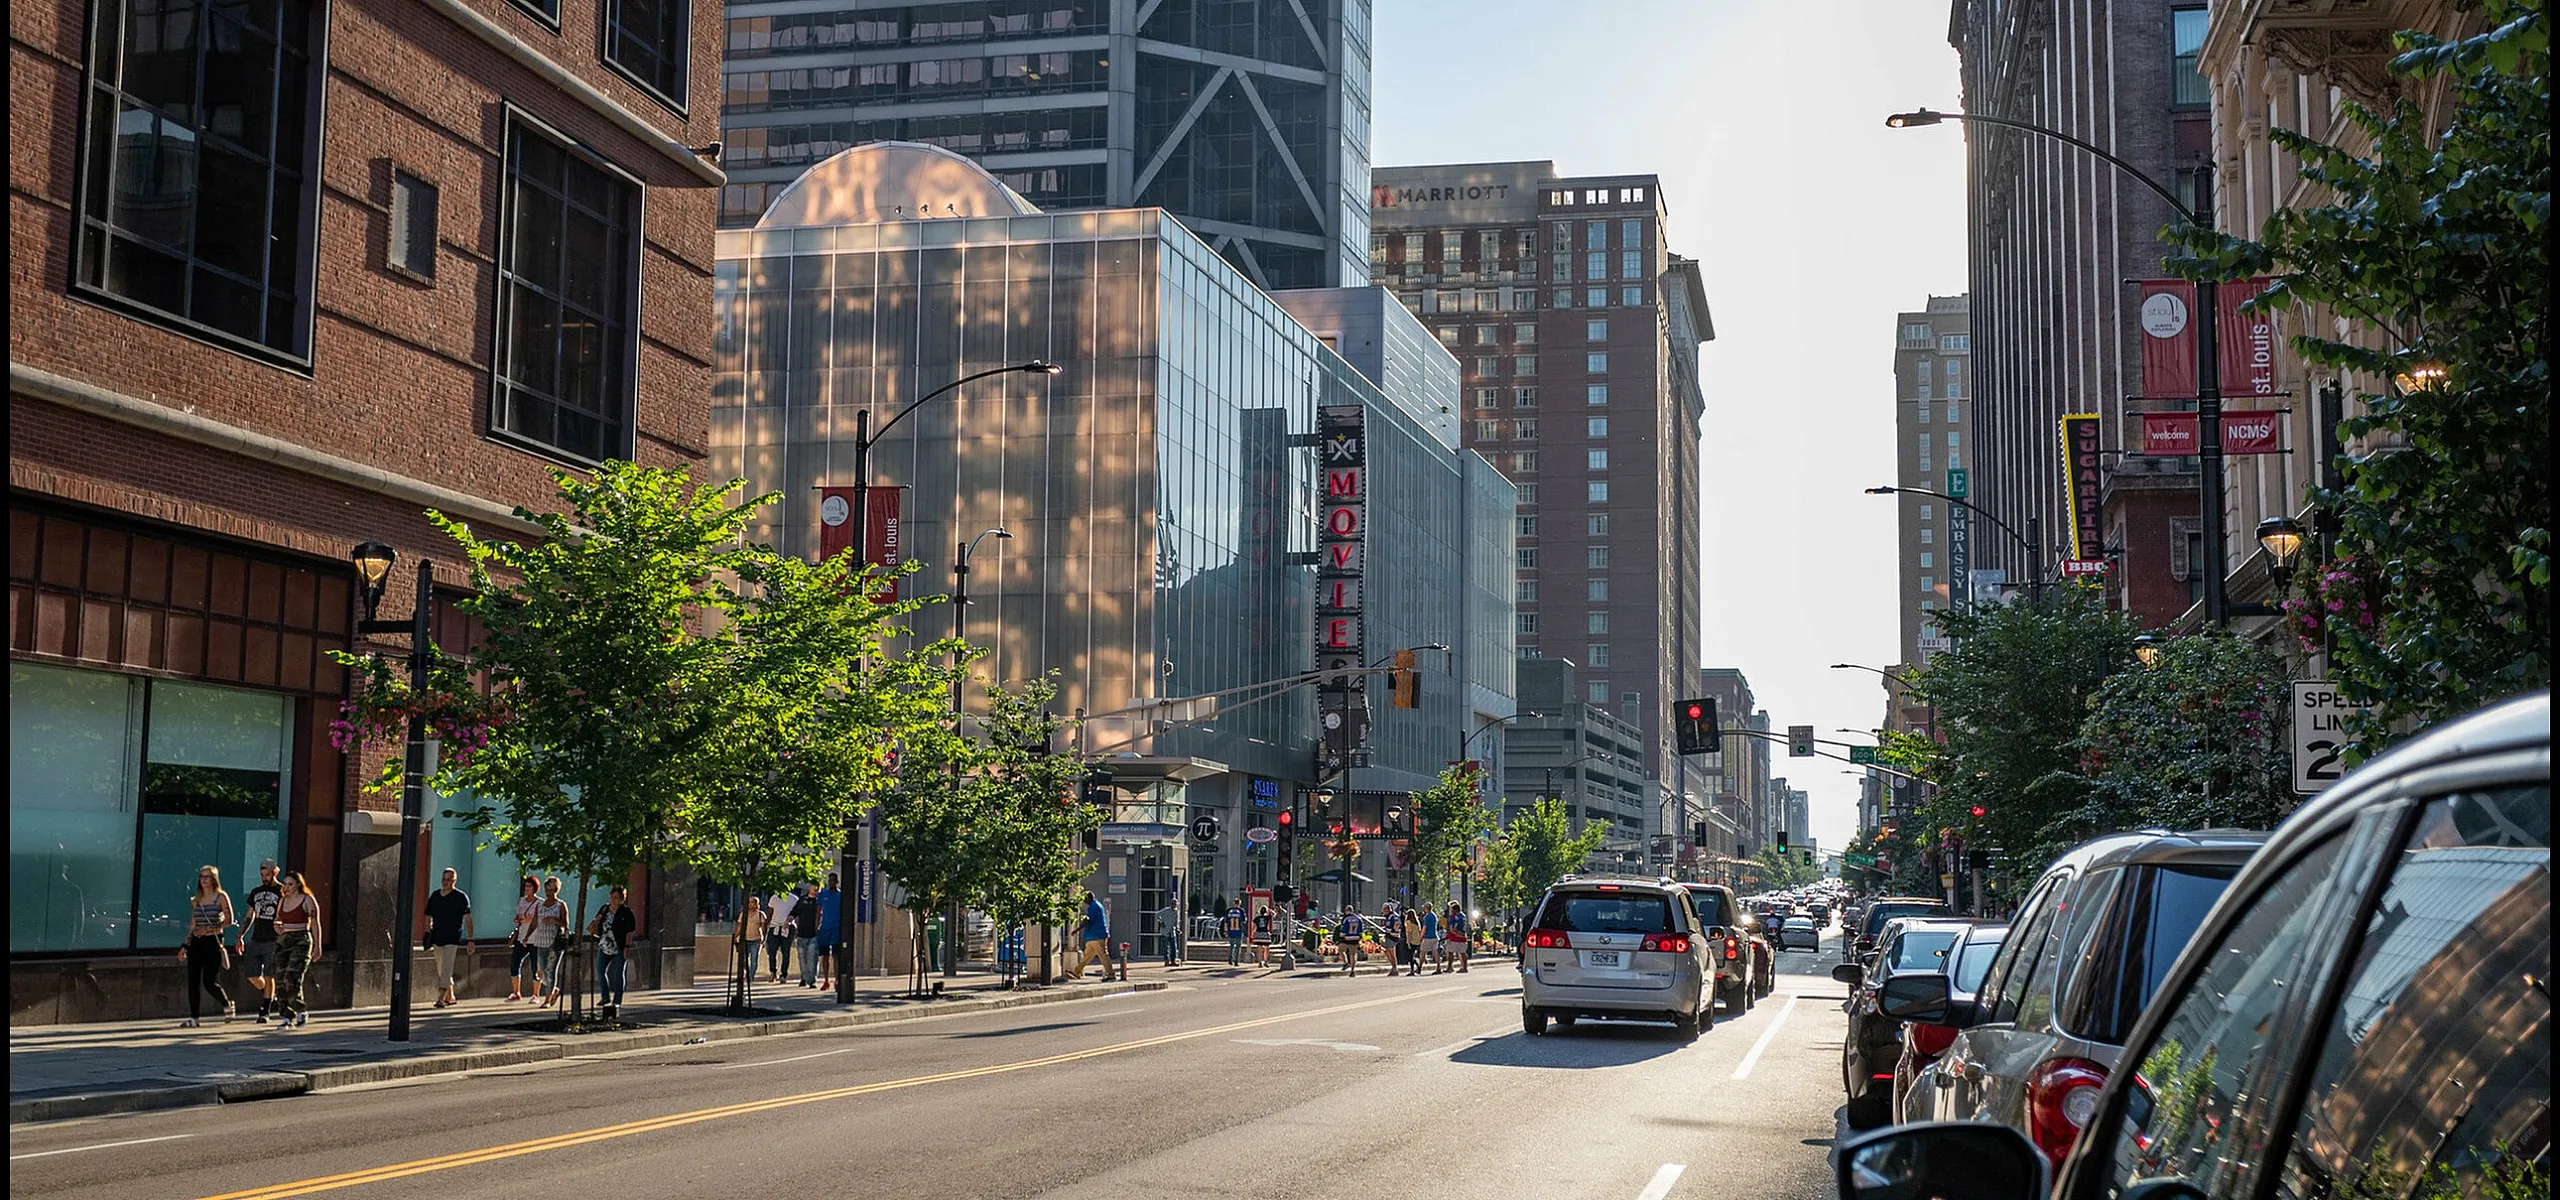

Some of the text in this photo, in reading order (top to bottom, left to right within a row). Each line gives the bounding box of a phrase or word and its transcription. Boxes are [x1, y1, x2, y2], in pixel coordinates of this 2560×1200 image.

[1398, 185, 1508, 203] MARRIOTT
[2249, 324, 2270, 368] louis
[2152, 430, 2190, 440] welcome
[2228, 424, 2270, 439] NCMS
[2079, 423, 2098, 557] SUGARFIRE
[883, 517, 898, 547] louis
[1951, 507, 1966, 589] EMBASSY
[1328, 471, 1357, 648] MOVIE
